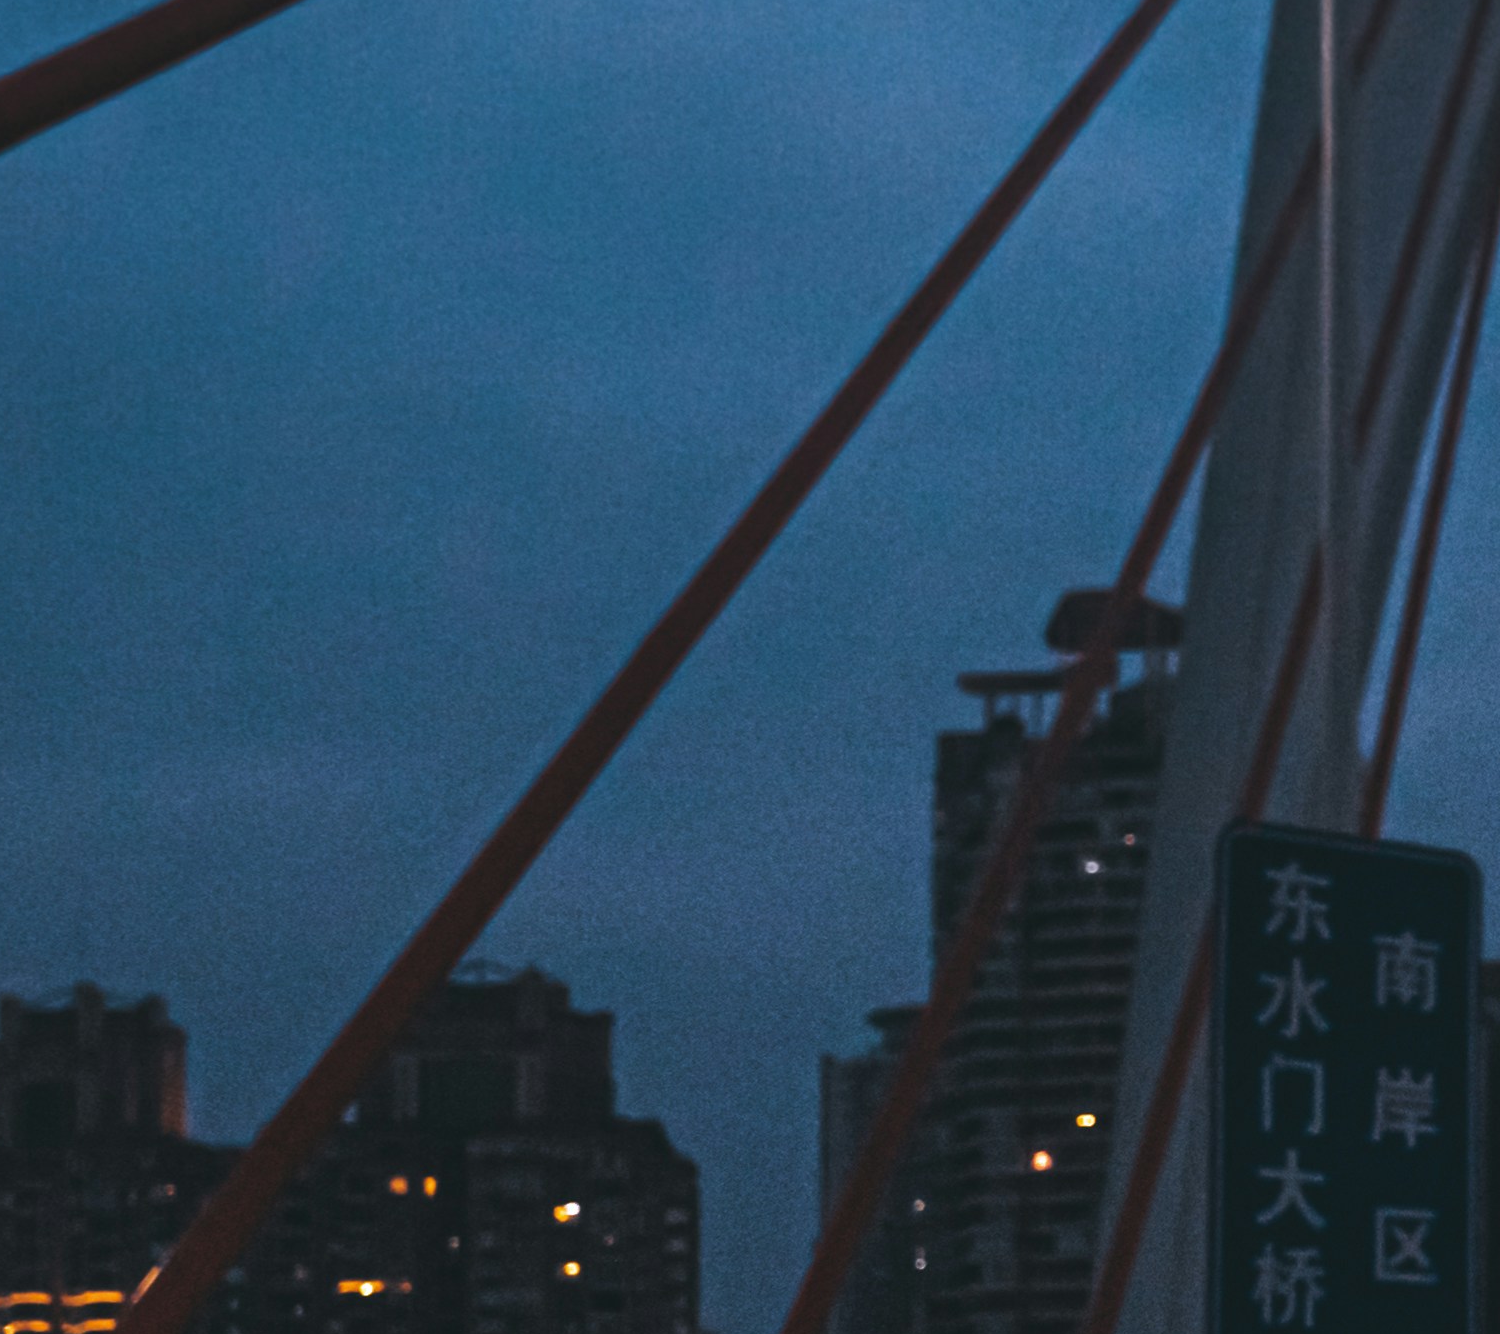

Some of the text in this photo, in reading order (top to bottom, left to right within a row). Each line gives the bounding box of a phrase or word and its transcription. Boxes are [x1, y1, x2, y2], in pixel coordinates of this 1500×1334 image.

[1252, 864, 1333, 1329] 东水门大桥
[1370, 930, 1442, 1285] 南岸区
